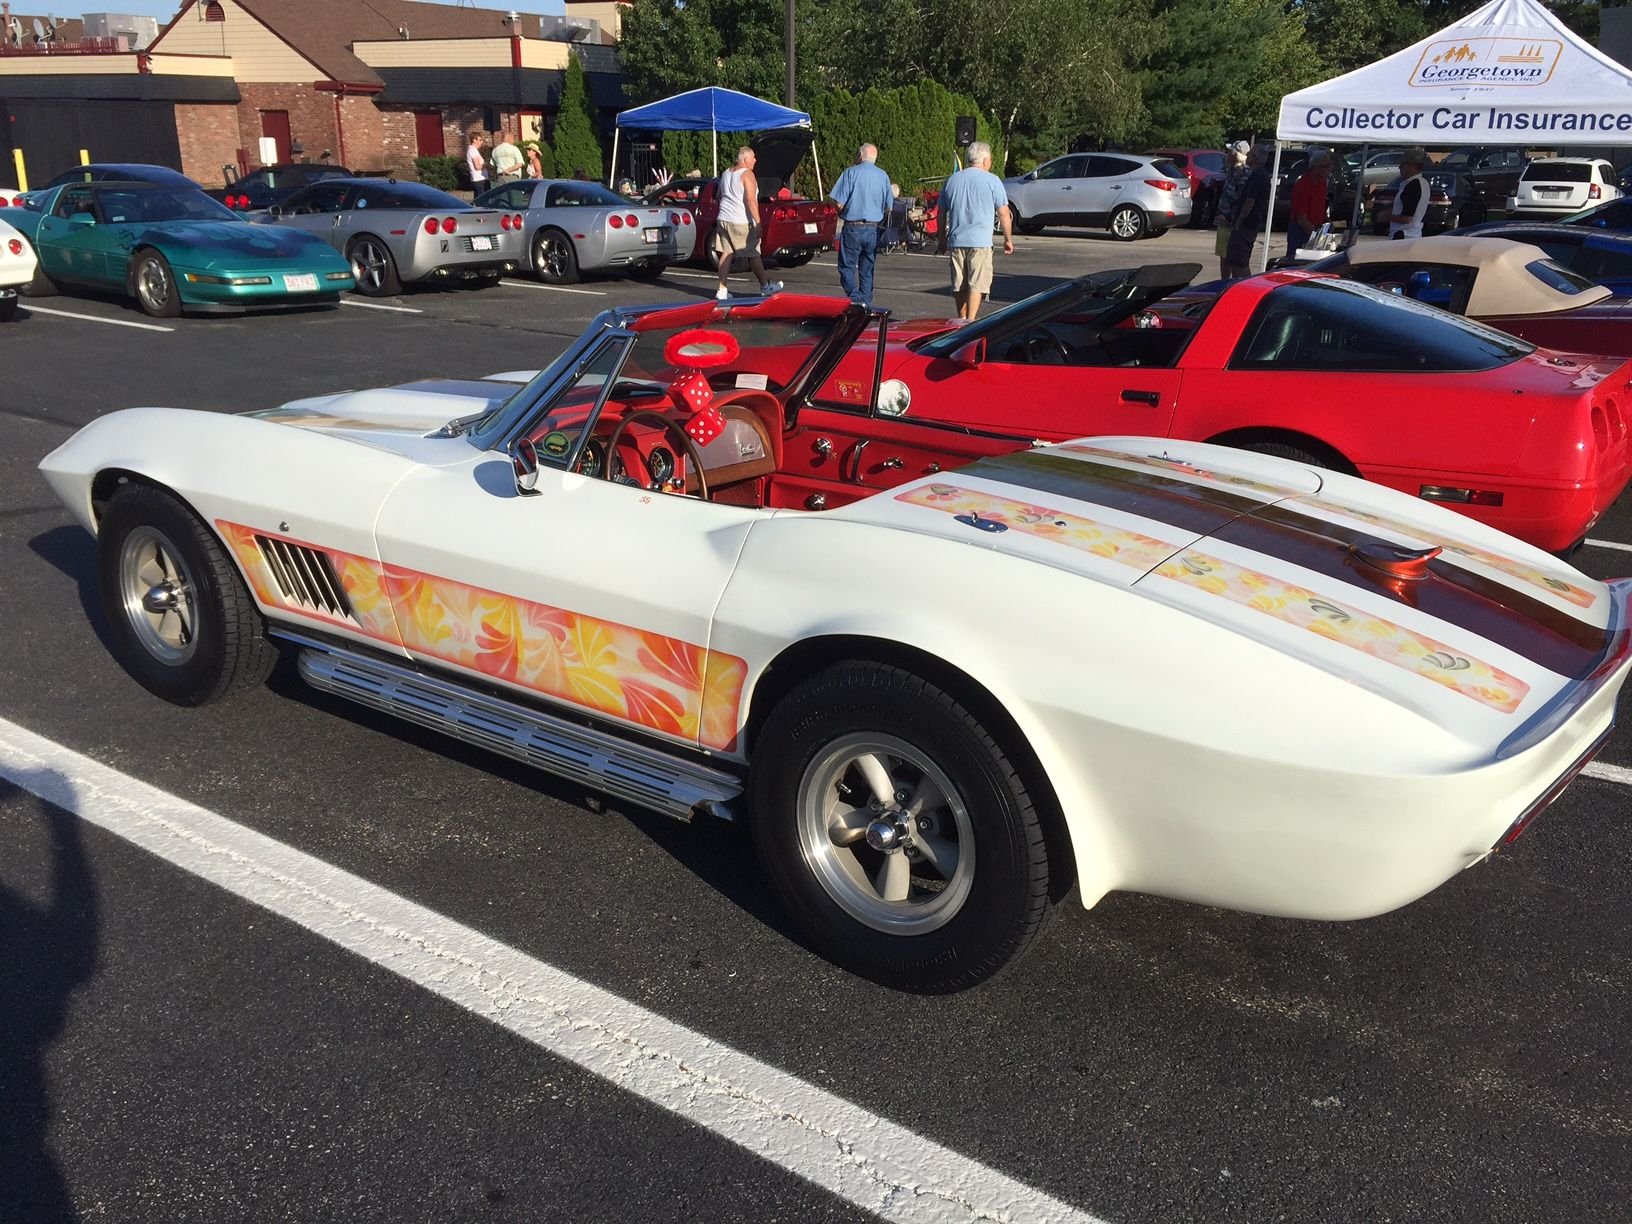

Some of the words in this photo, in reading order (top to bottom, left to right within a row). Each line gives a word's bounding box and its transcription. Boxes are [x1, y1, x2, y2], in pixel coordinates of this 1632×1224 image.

[1422, 65, 1542, 80] Georgetown
[1306, 107, 1424, 129] Collector
[1432, 107, 1480, 129] Car
[1487, 107, 1632, 131] Insurance
